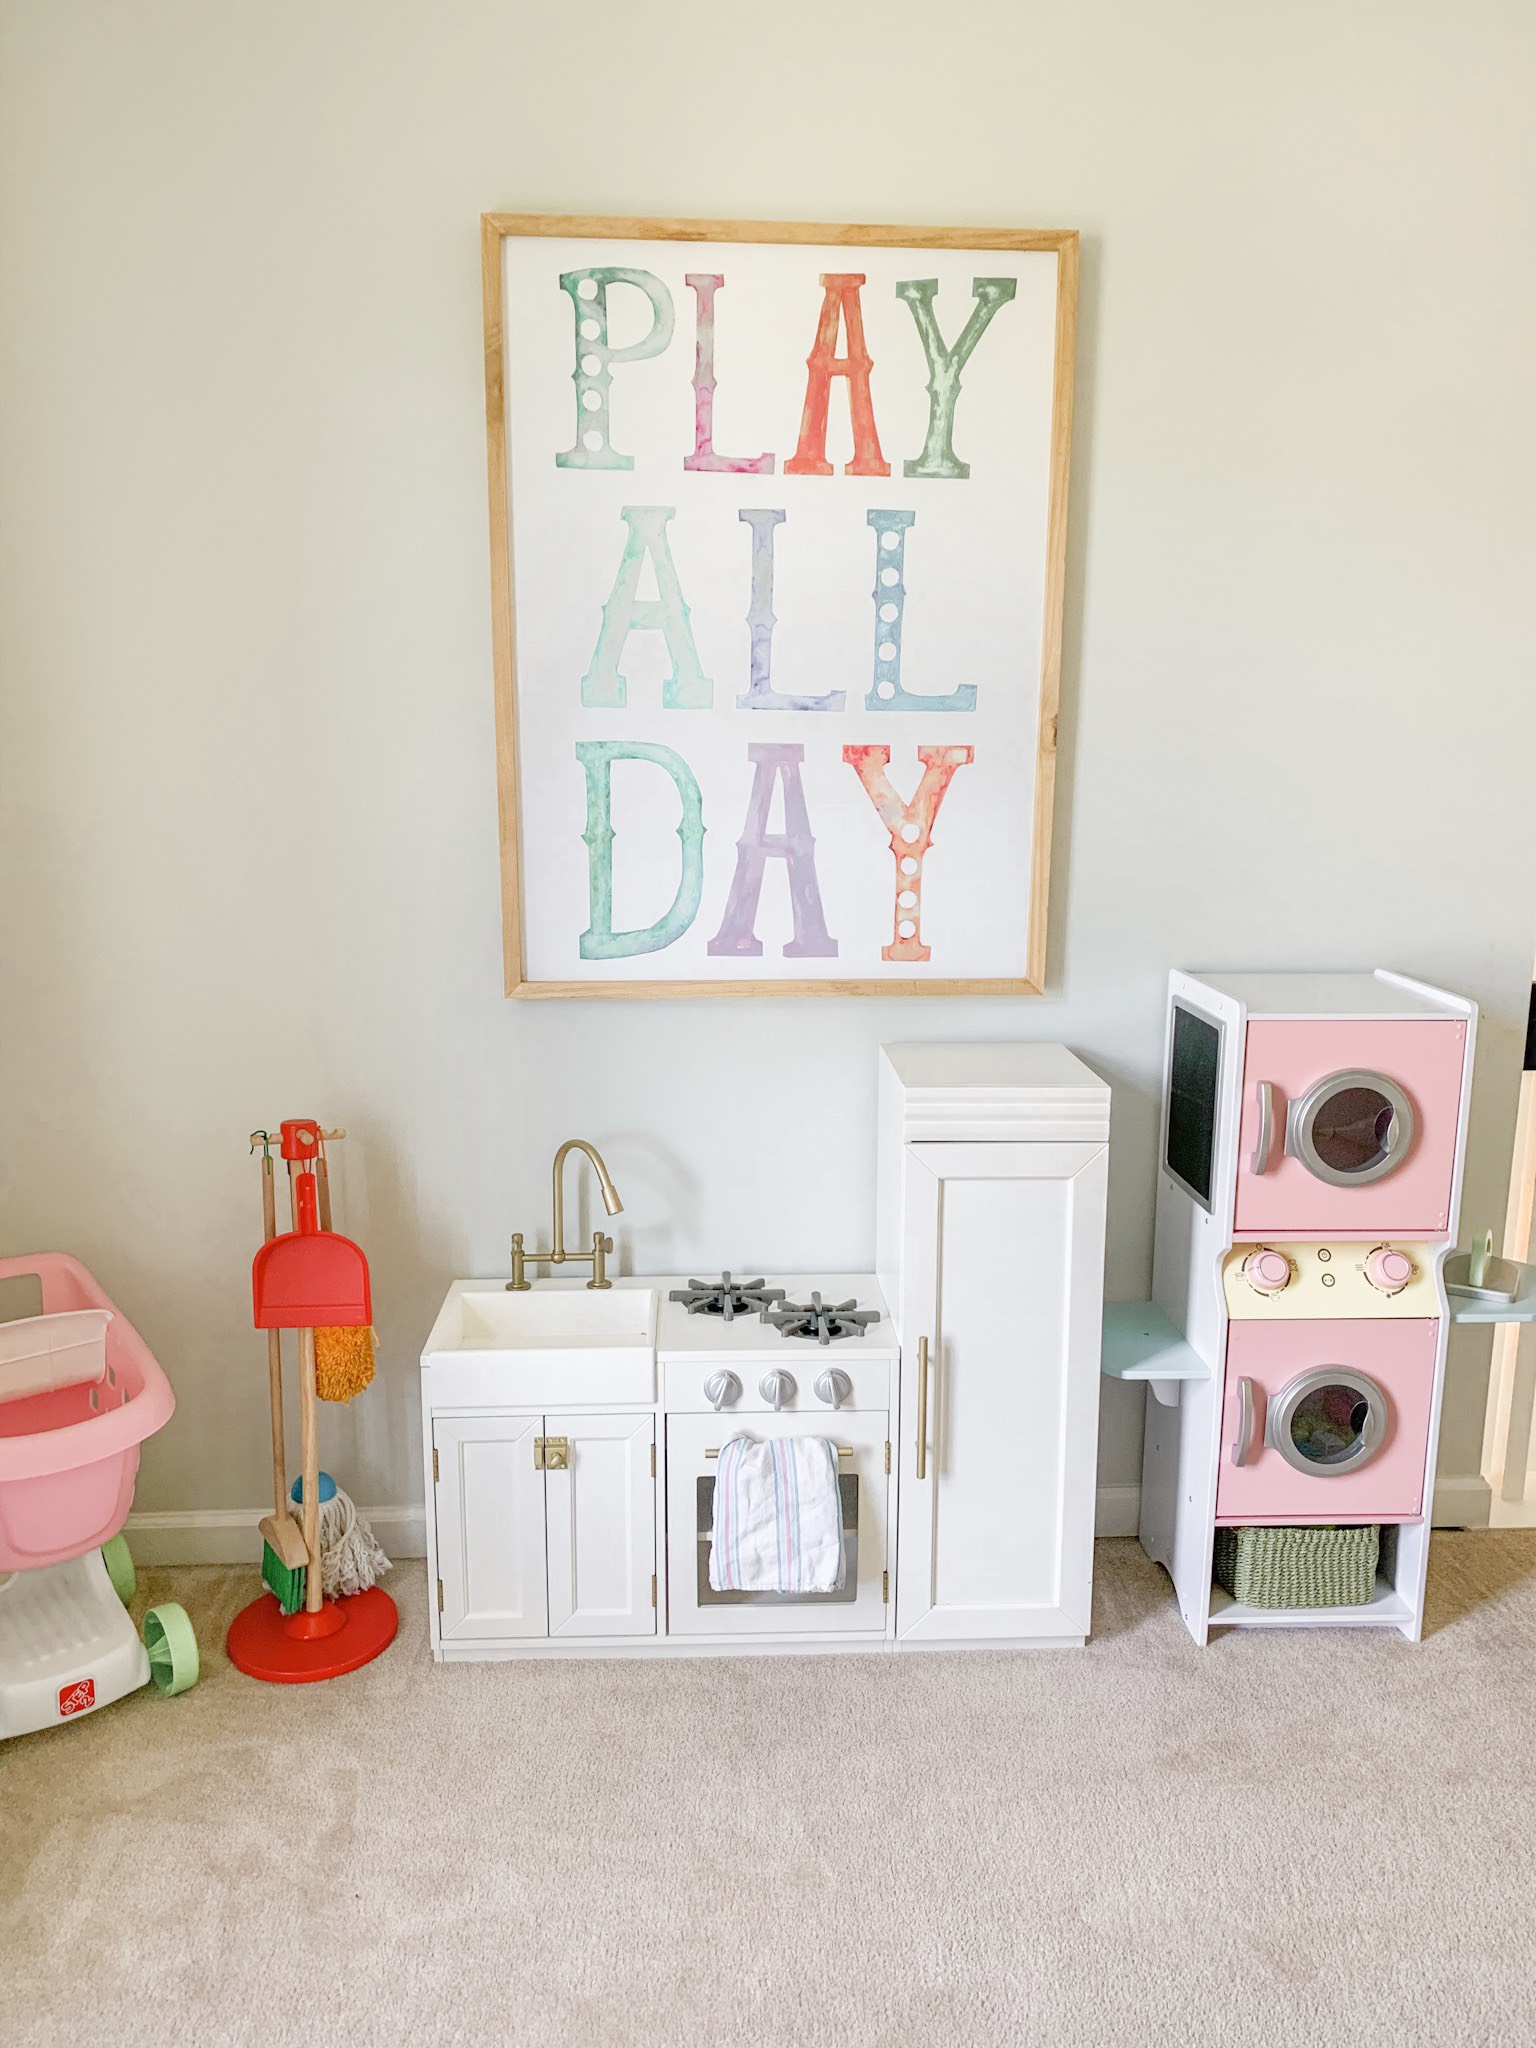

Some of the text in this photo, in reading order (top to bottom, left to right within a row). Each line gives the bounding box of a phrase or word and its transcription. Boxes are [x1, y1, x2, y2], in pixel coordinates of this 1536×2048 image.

[555, 266, 1018, 480] PLAY
[581, 506, 978, 712] ALL
[575, 741, 976, 962] DAY
[61, 1680, 90, 1714] STEP
[80, 1696, 95, 1708] 2
